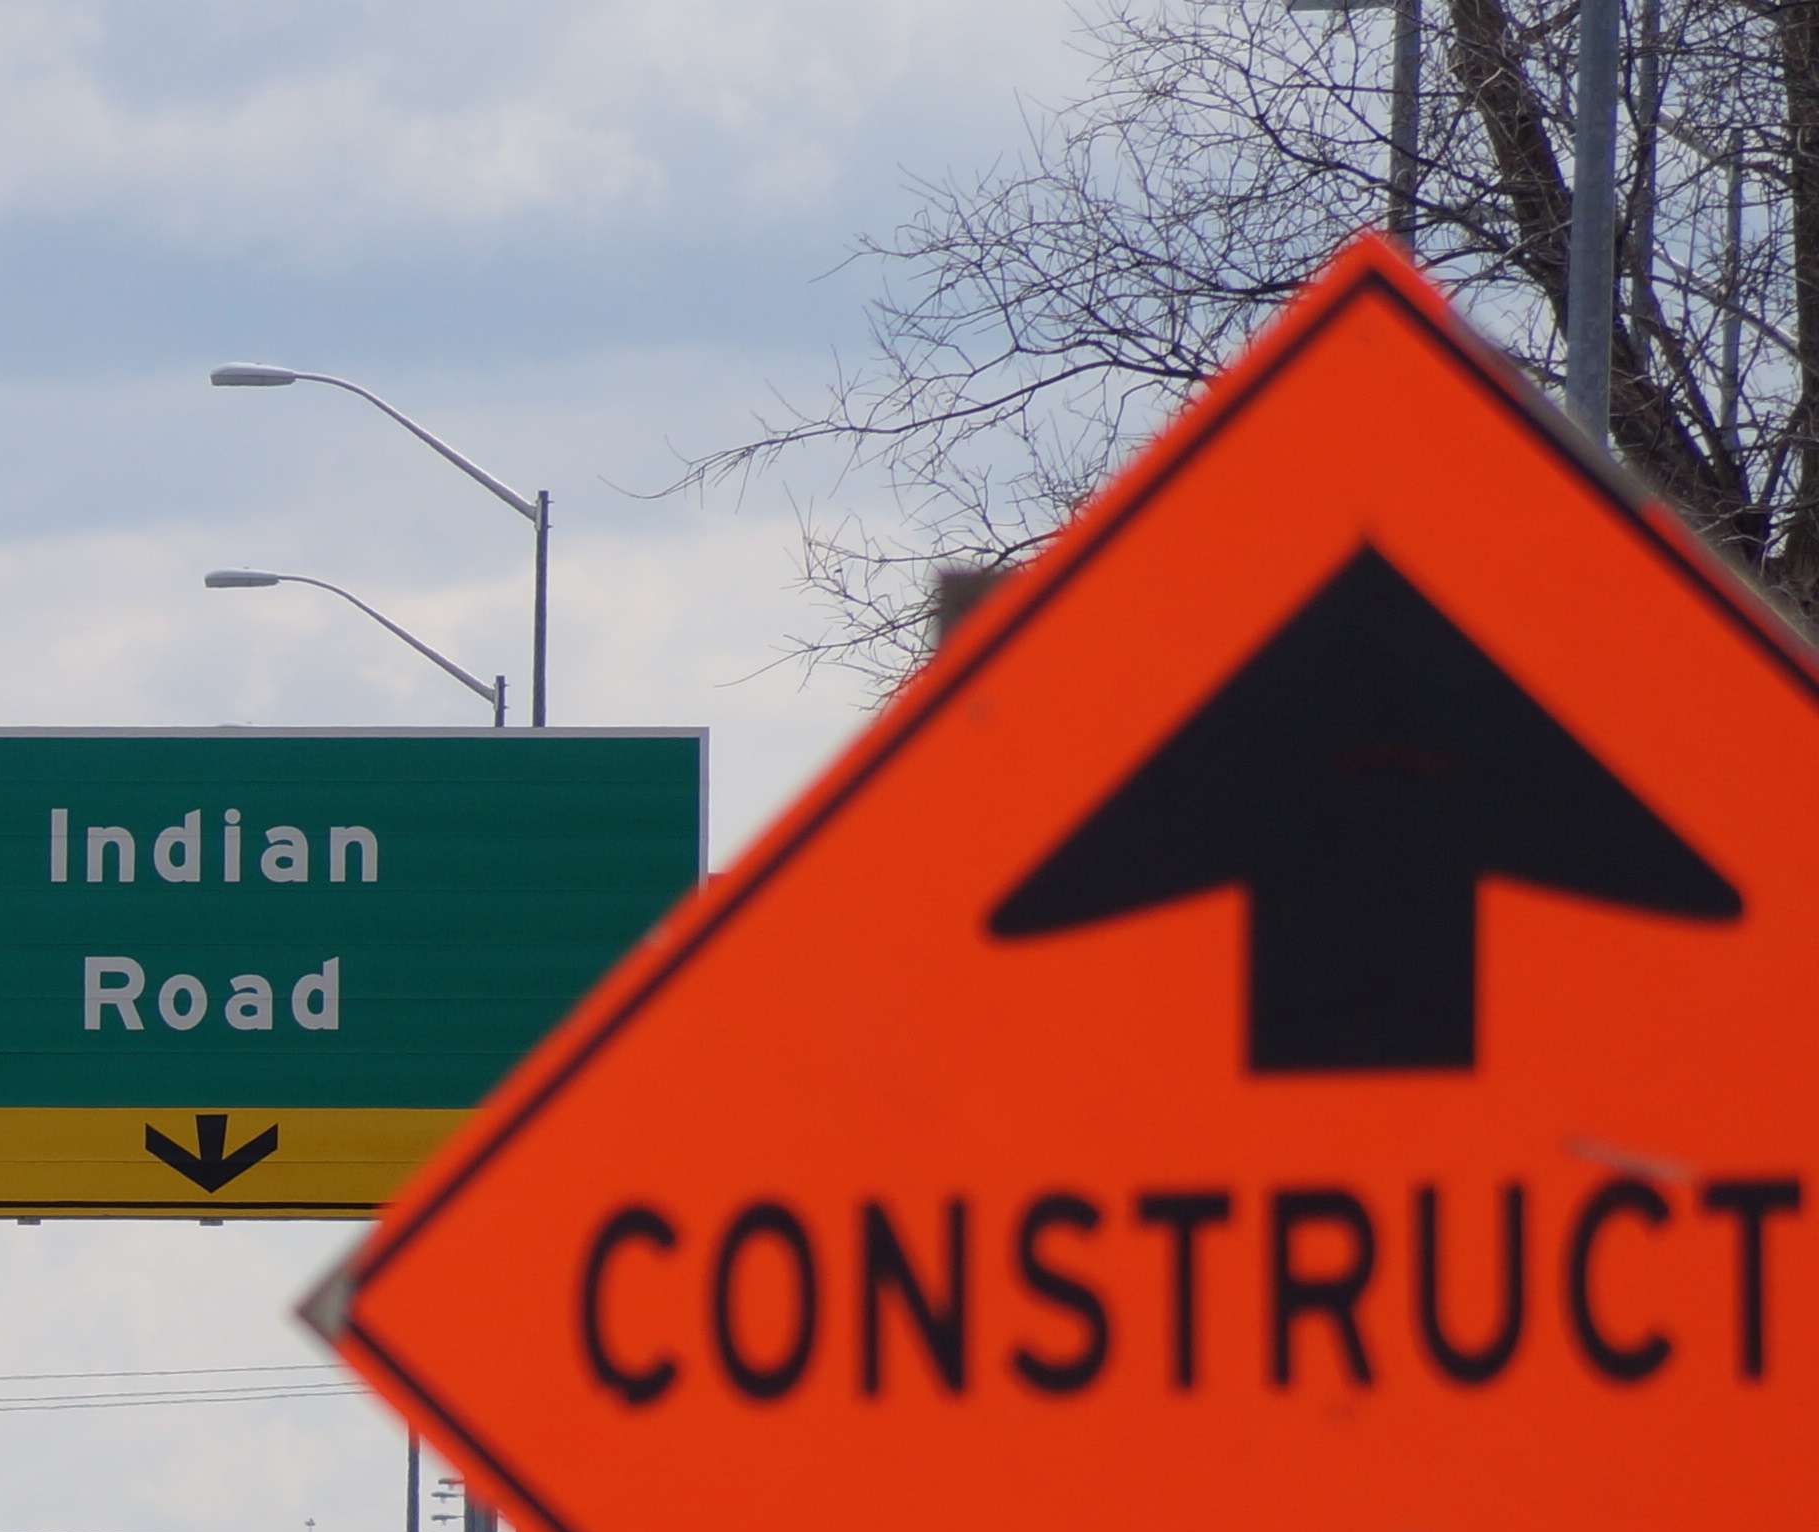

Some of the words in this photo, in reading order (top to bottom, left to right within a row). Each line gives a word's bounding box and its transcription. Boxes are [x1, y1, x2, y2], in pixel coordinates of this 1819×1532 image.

[49, 807, 379, 884] Indian
[82, 955, 341, 1032] Road
[577, 1177, 1805, 1407] CONSTRUCT
